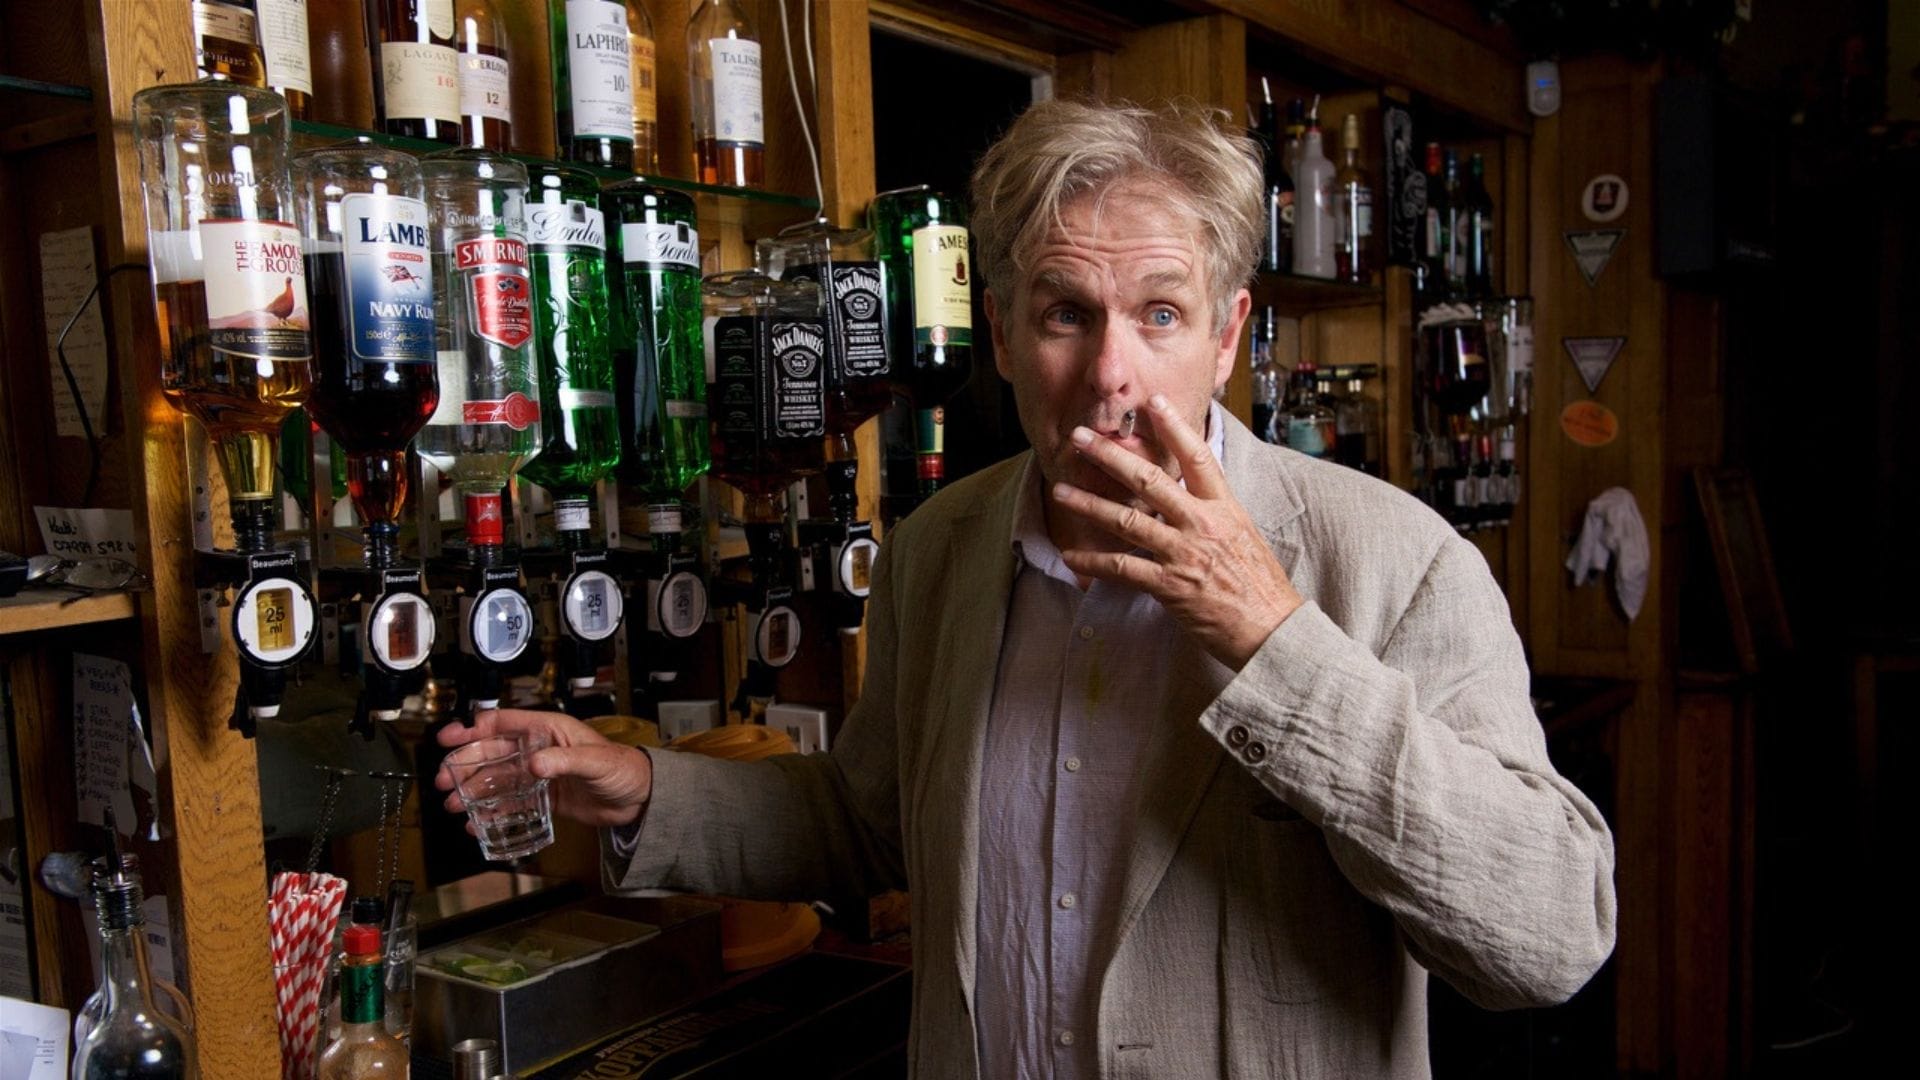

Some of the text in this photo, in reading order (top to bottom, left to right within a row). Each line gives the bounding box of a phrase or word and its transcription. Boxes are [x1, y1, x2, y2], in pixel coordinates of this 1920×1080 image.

[438, 76, 454, 88] 16
[613, 75, 625, 92] 10
[486, 92, 499, 104] 12
[929, 234, 968, 252] AMES
[235, 240, 250, 272] THE
[835, 276, 854, 300] JACK
[370, 301, 412, 318] NAVY
[772, 331, 794, 357] JACK
[784, 395, 818, 403] WHISKEY
[253, 558, 294, 569] Beaumont
[386, 574, 419, 583] Beaumont
[588, 594, 601, 607] 25
[266, 606, 285, 623] 25
[270, 622, 282, 634] ml
[507, 615, 523, 630] 50
